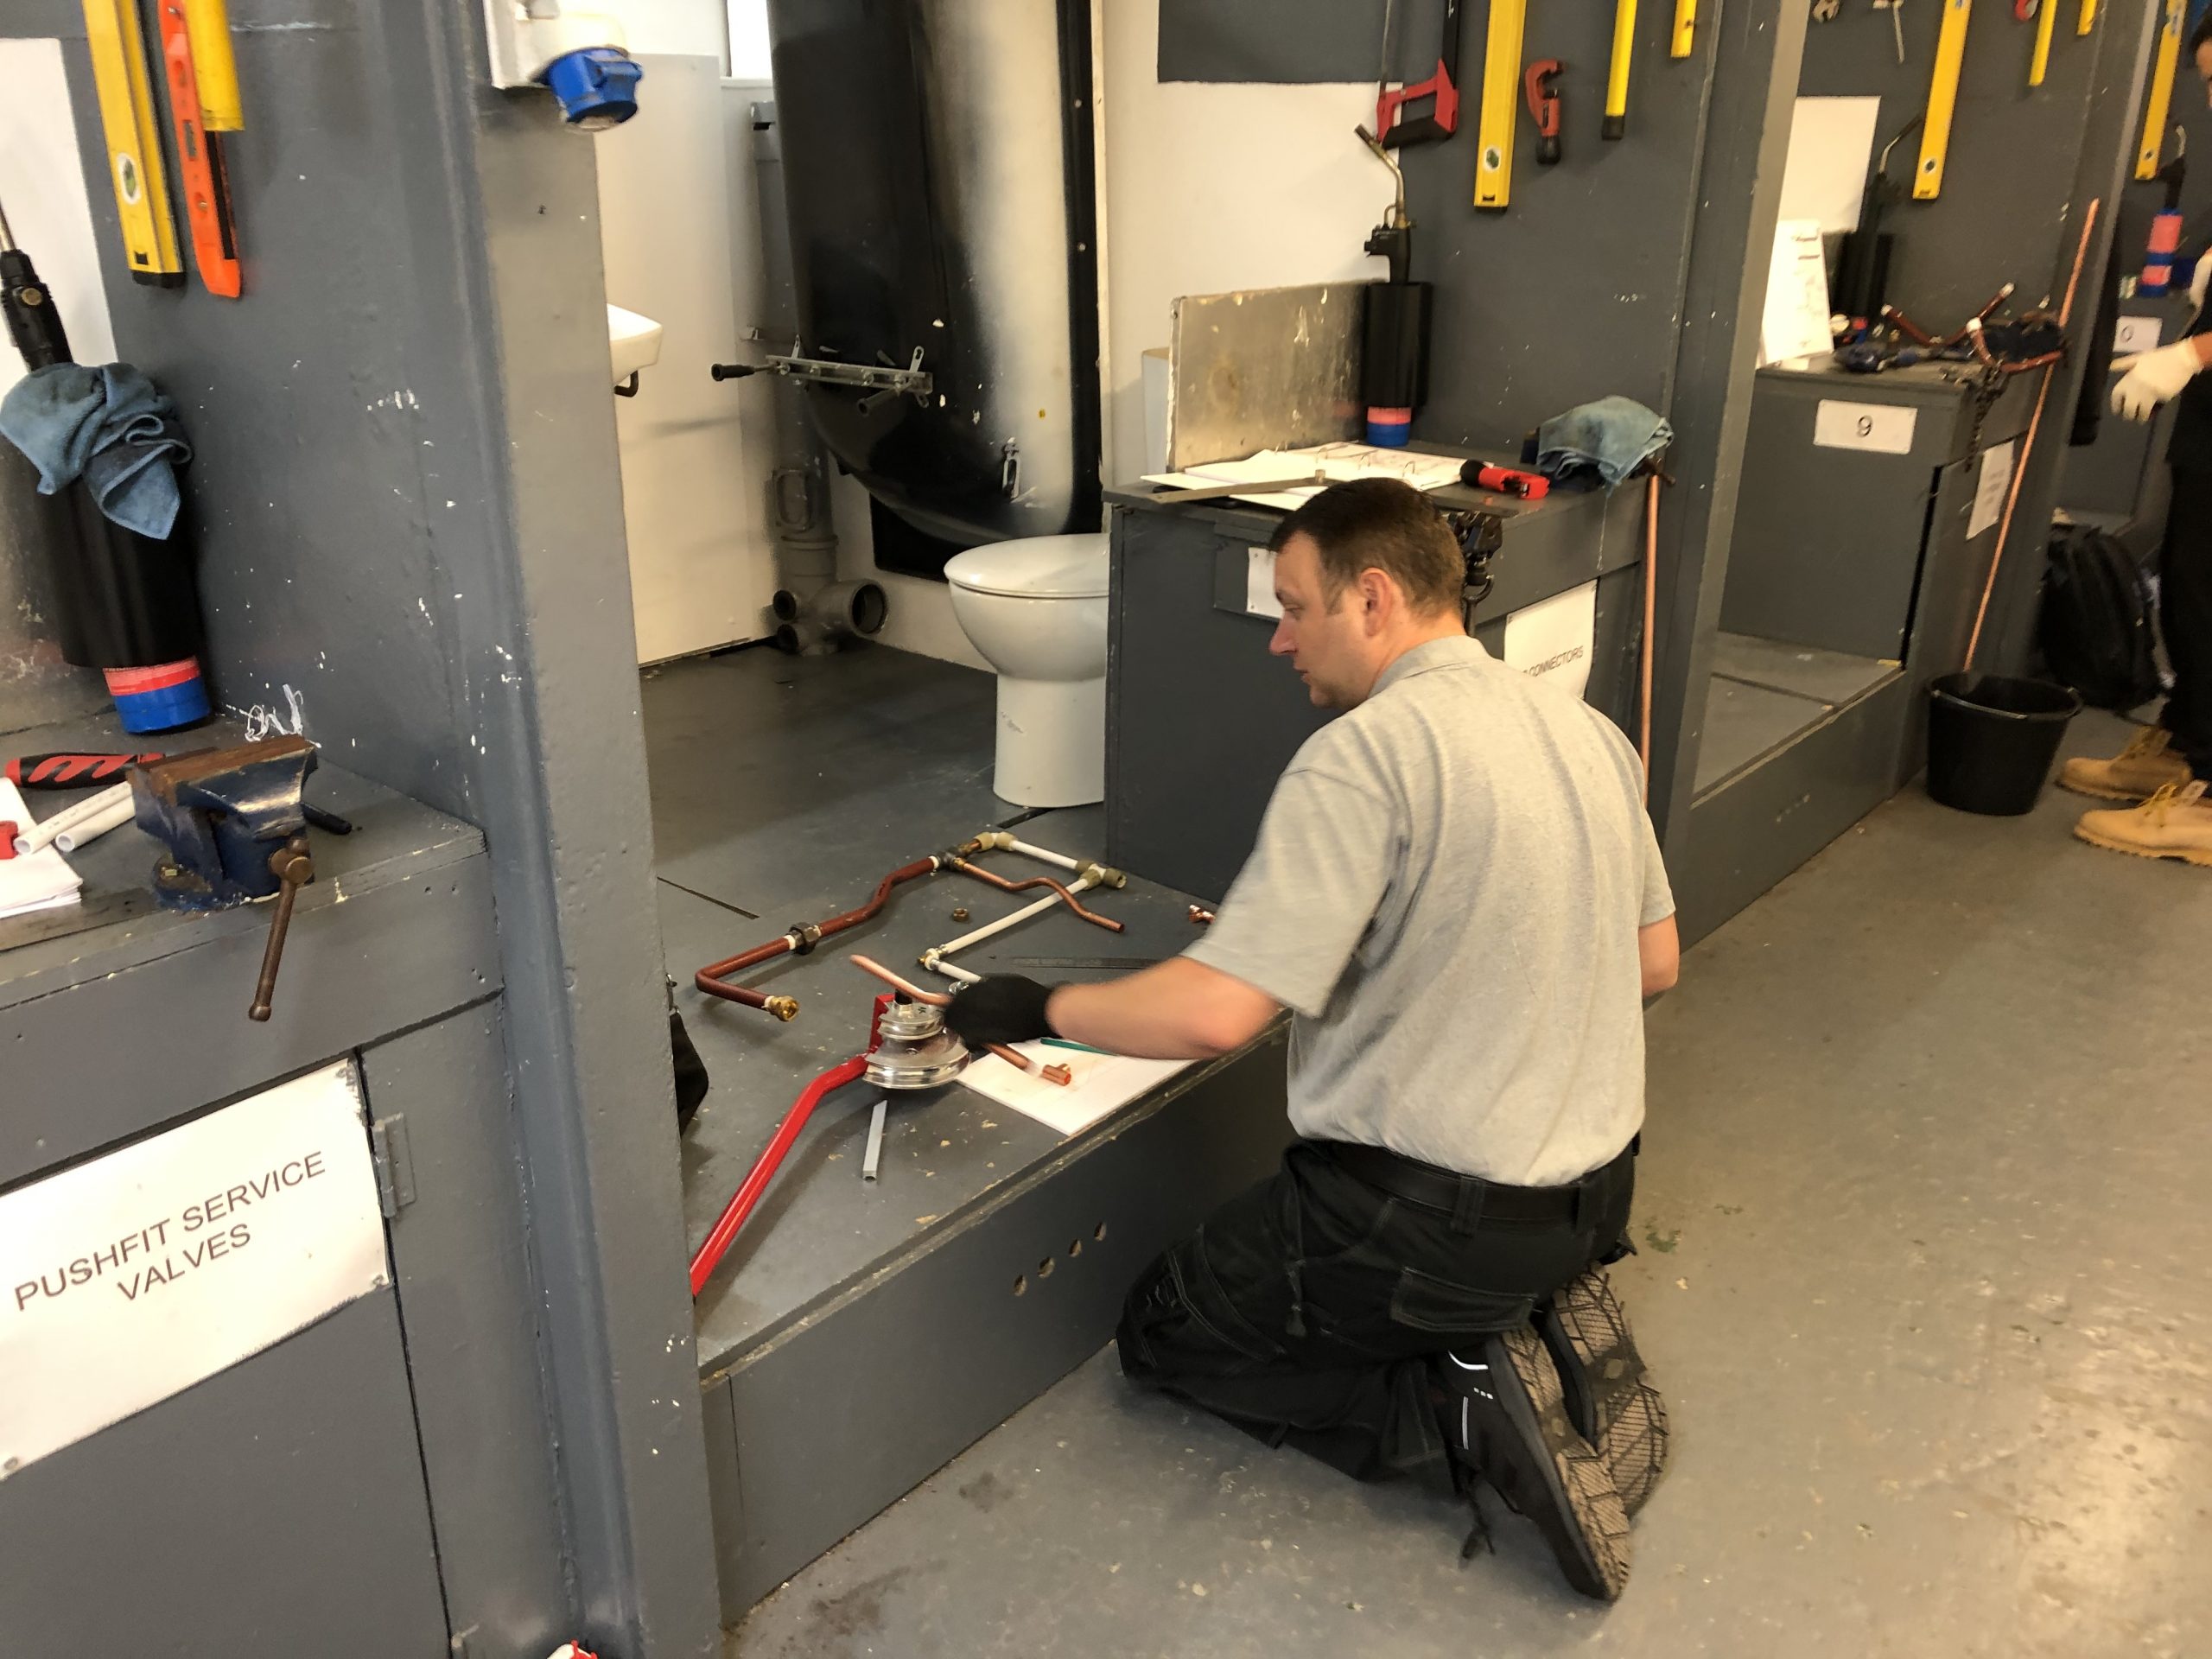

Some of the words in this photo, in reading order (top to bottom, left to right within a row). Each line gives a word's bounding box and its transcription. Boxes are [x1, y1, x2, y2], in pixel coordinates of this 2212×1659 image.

[1857, 415, 1872, 437] 9
[1529, 645, 1583, 677] CONNECTORS
[14, 1217, 171, 1311] PUSHFIT
[182, 1151, 326, 1232] SERVICE
[118, 1223, 251, 1300] VALVES
